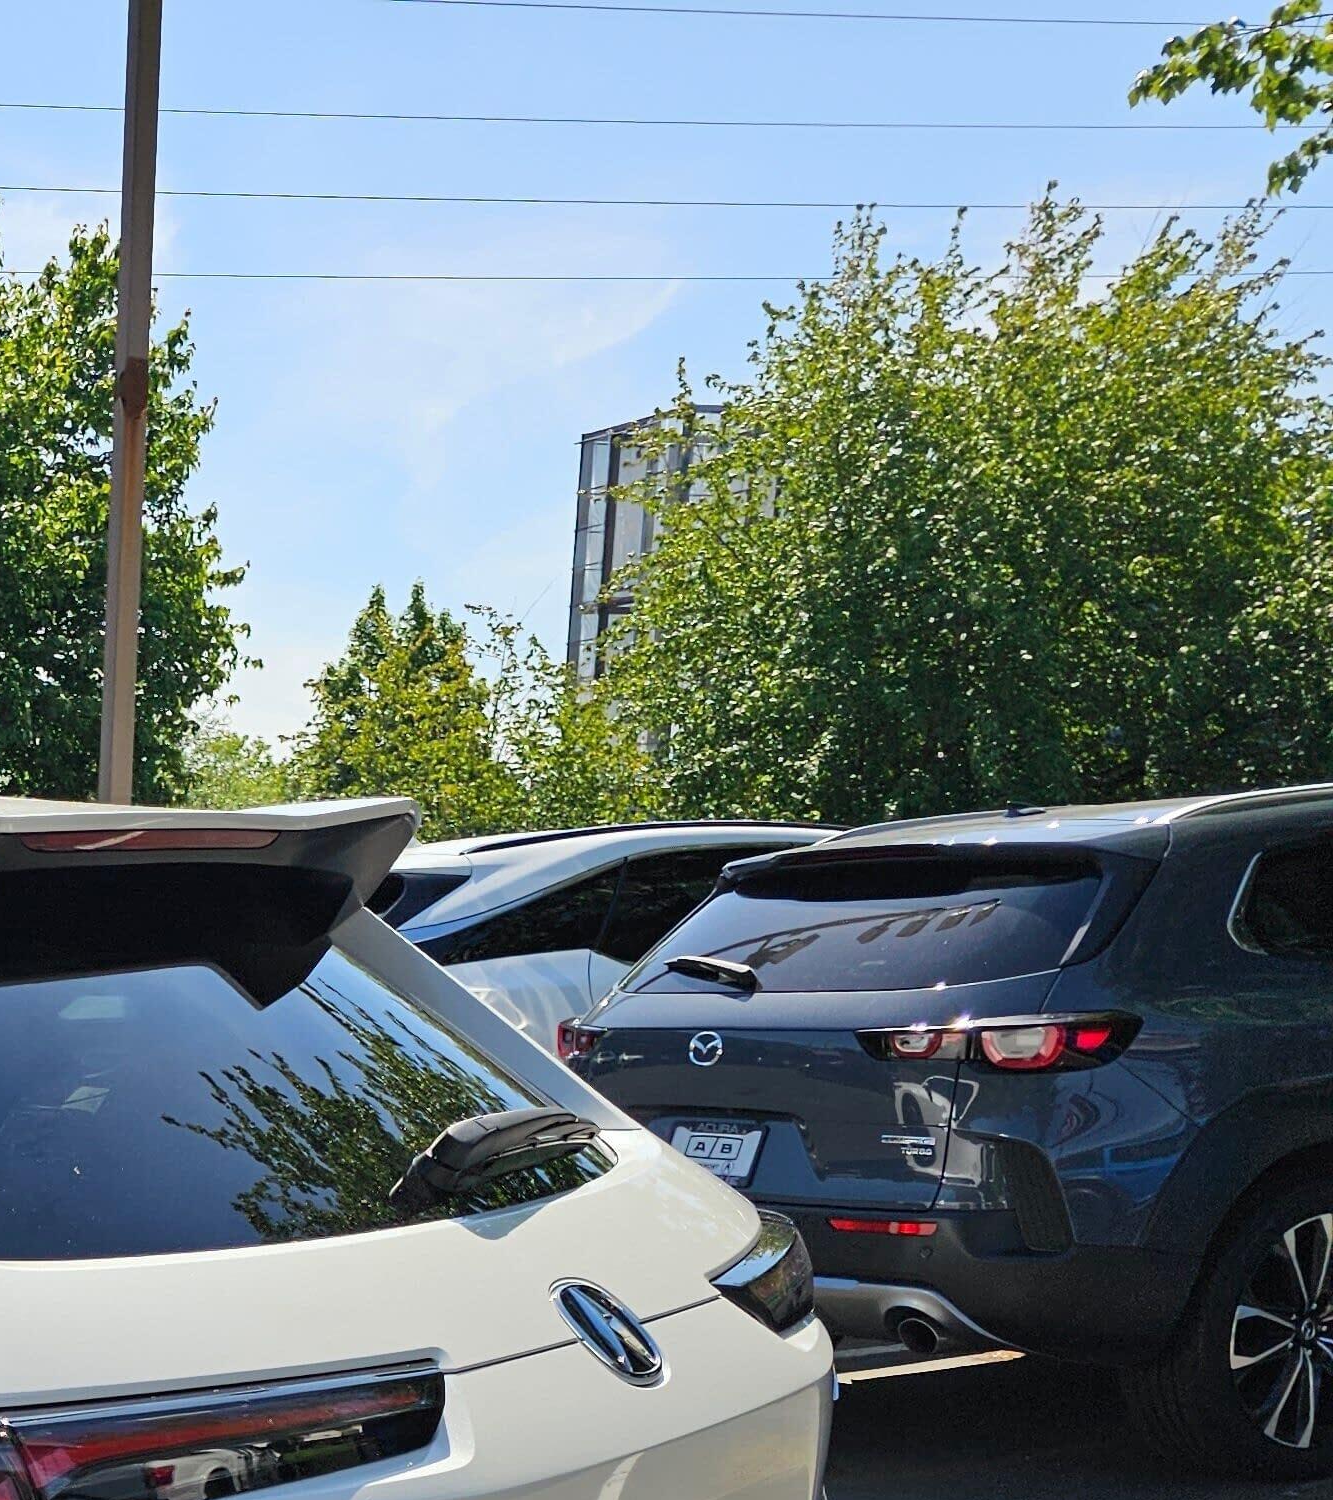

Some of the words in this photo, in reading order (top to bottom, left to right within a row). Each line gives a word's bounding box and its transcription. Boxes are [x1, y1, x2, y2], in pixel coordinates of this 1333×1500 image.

[697, 1123, 739, 1134] ACURA
[693, 1141, 706, 1152] A
[720, 1143, 733, 1154] B
